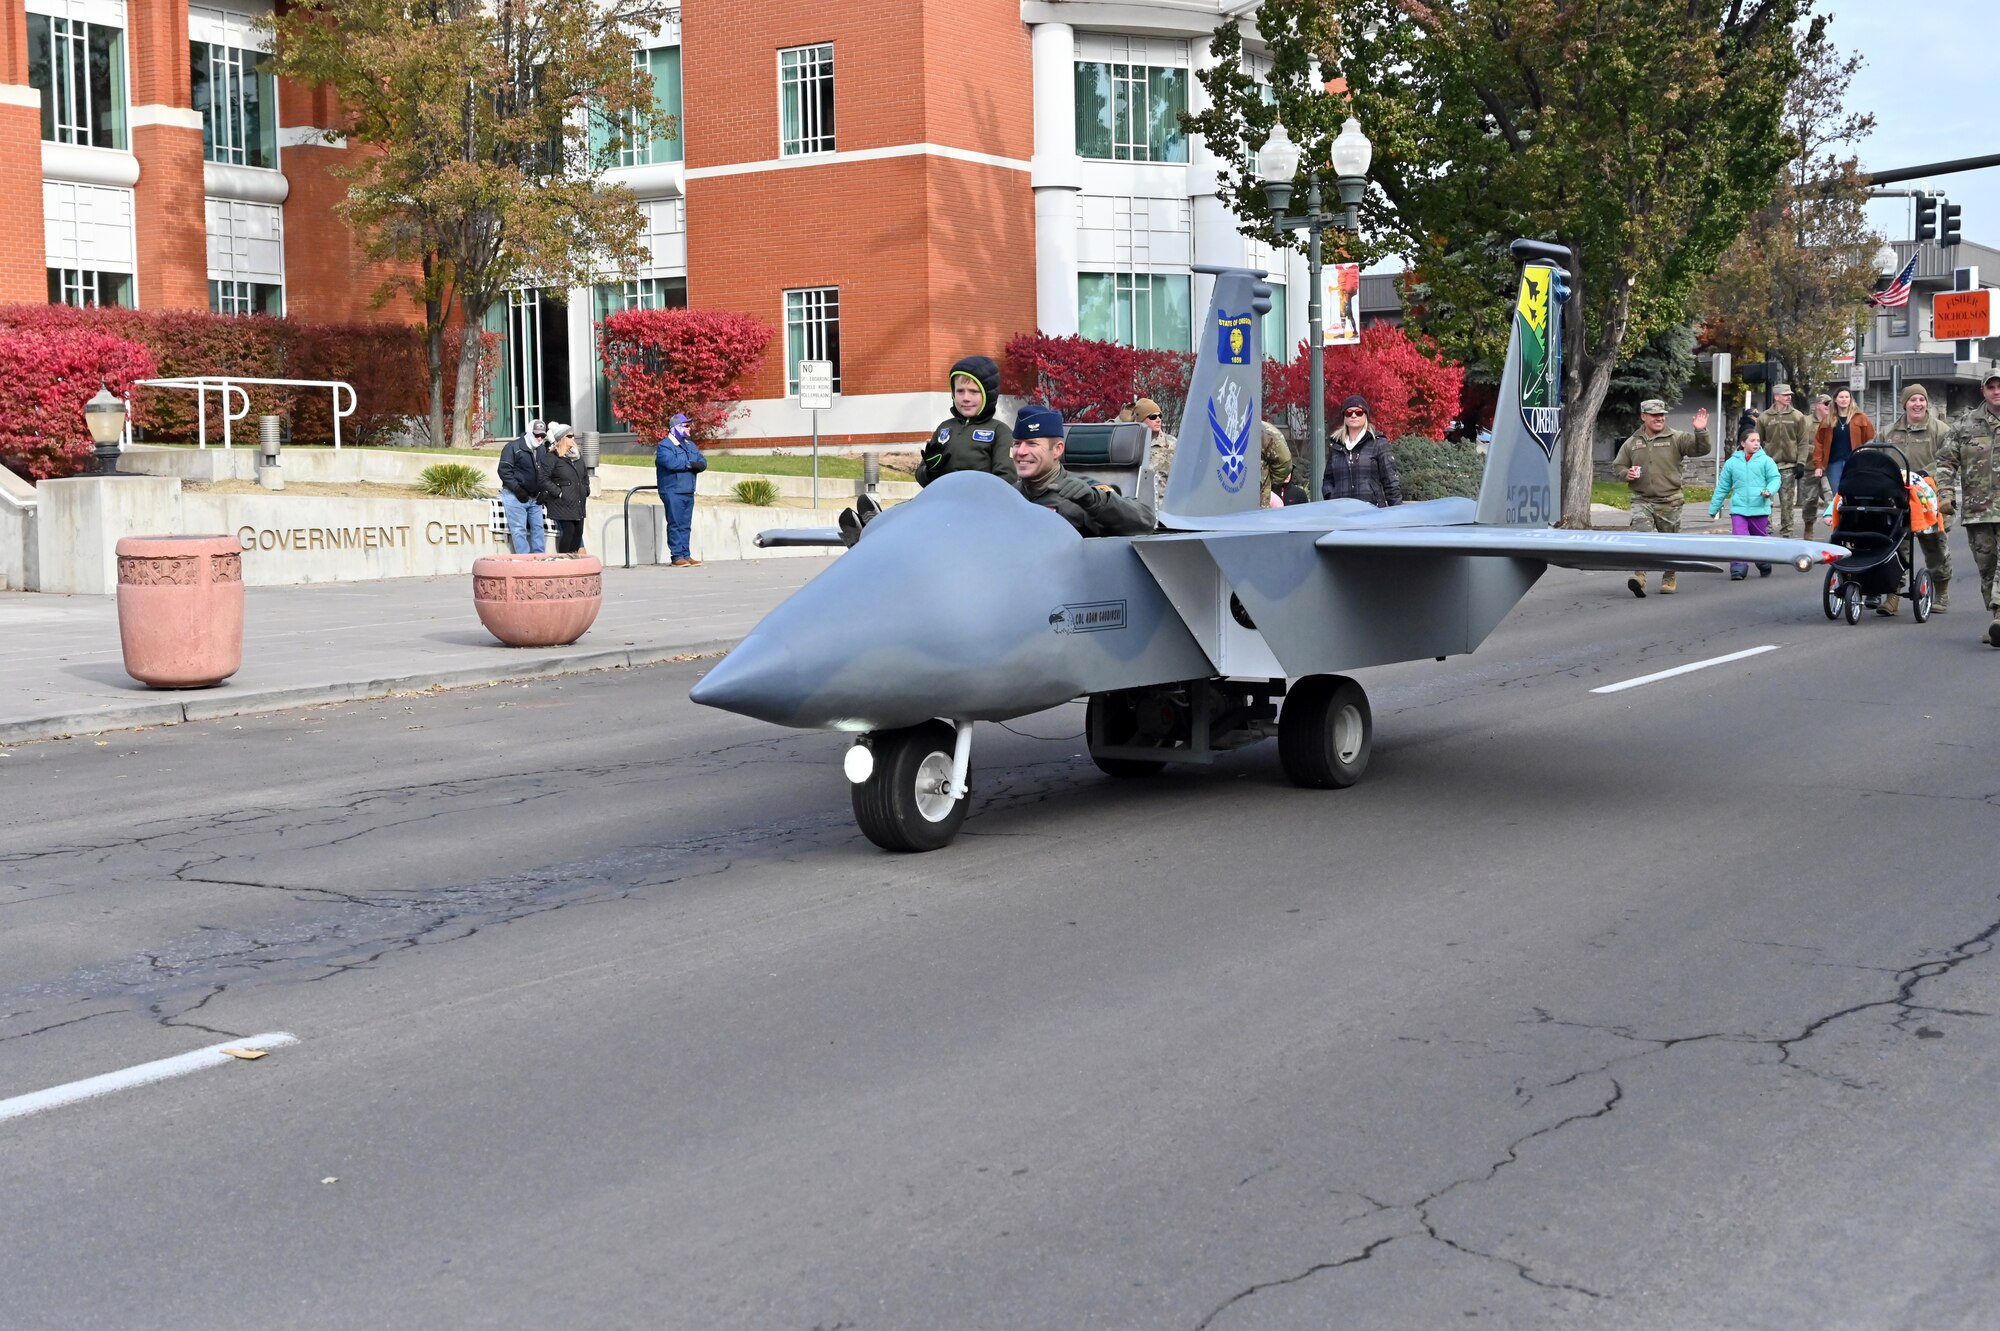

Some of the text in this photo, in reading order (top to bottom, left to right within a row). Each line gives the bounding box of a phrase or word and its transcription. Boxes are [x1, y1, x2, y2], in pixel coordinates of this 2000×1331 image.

[1946, 295, 1978, 309] FISHER
[1938, 310, 1987, 320] NICHOLSON
[803, 364, 813, 373] NO
[1507, 486, 1517, 502] AF
[1517, 485, 1550, 523] 250
[237, 520, 512, 551] GOVERNMENT CENTE
[1076, 613, 1084, 625] COL
